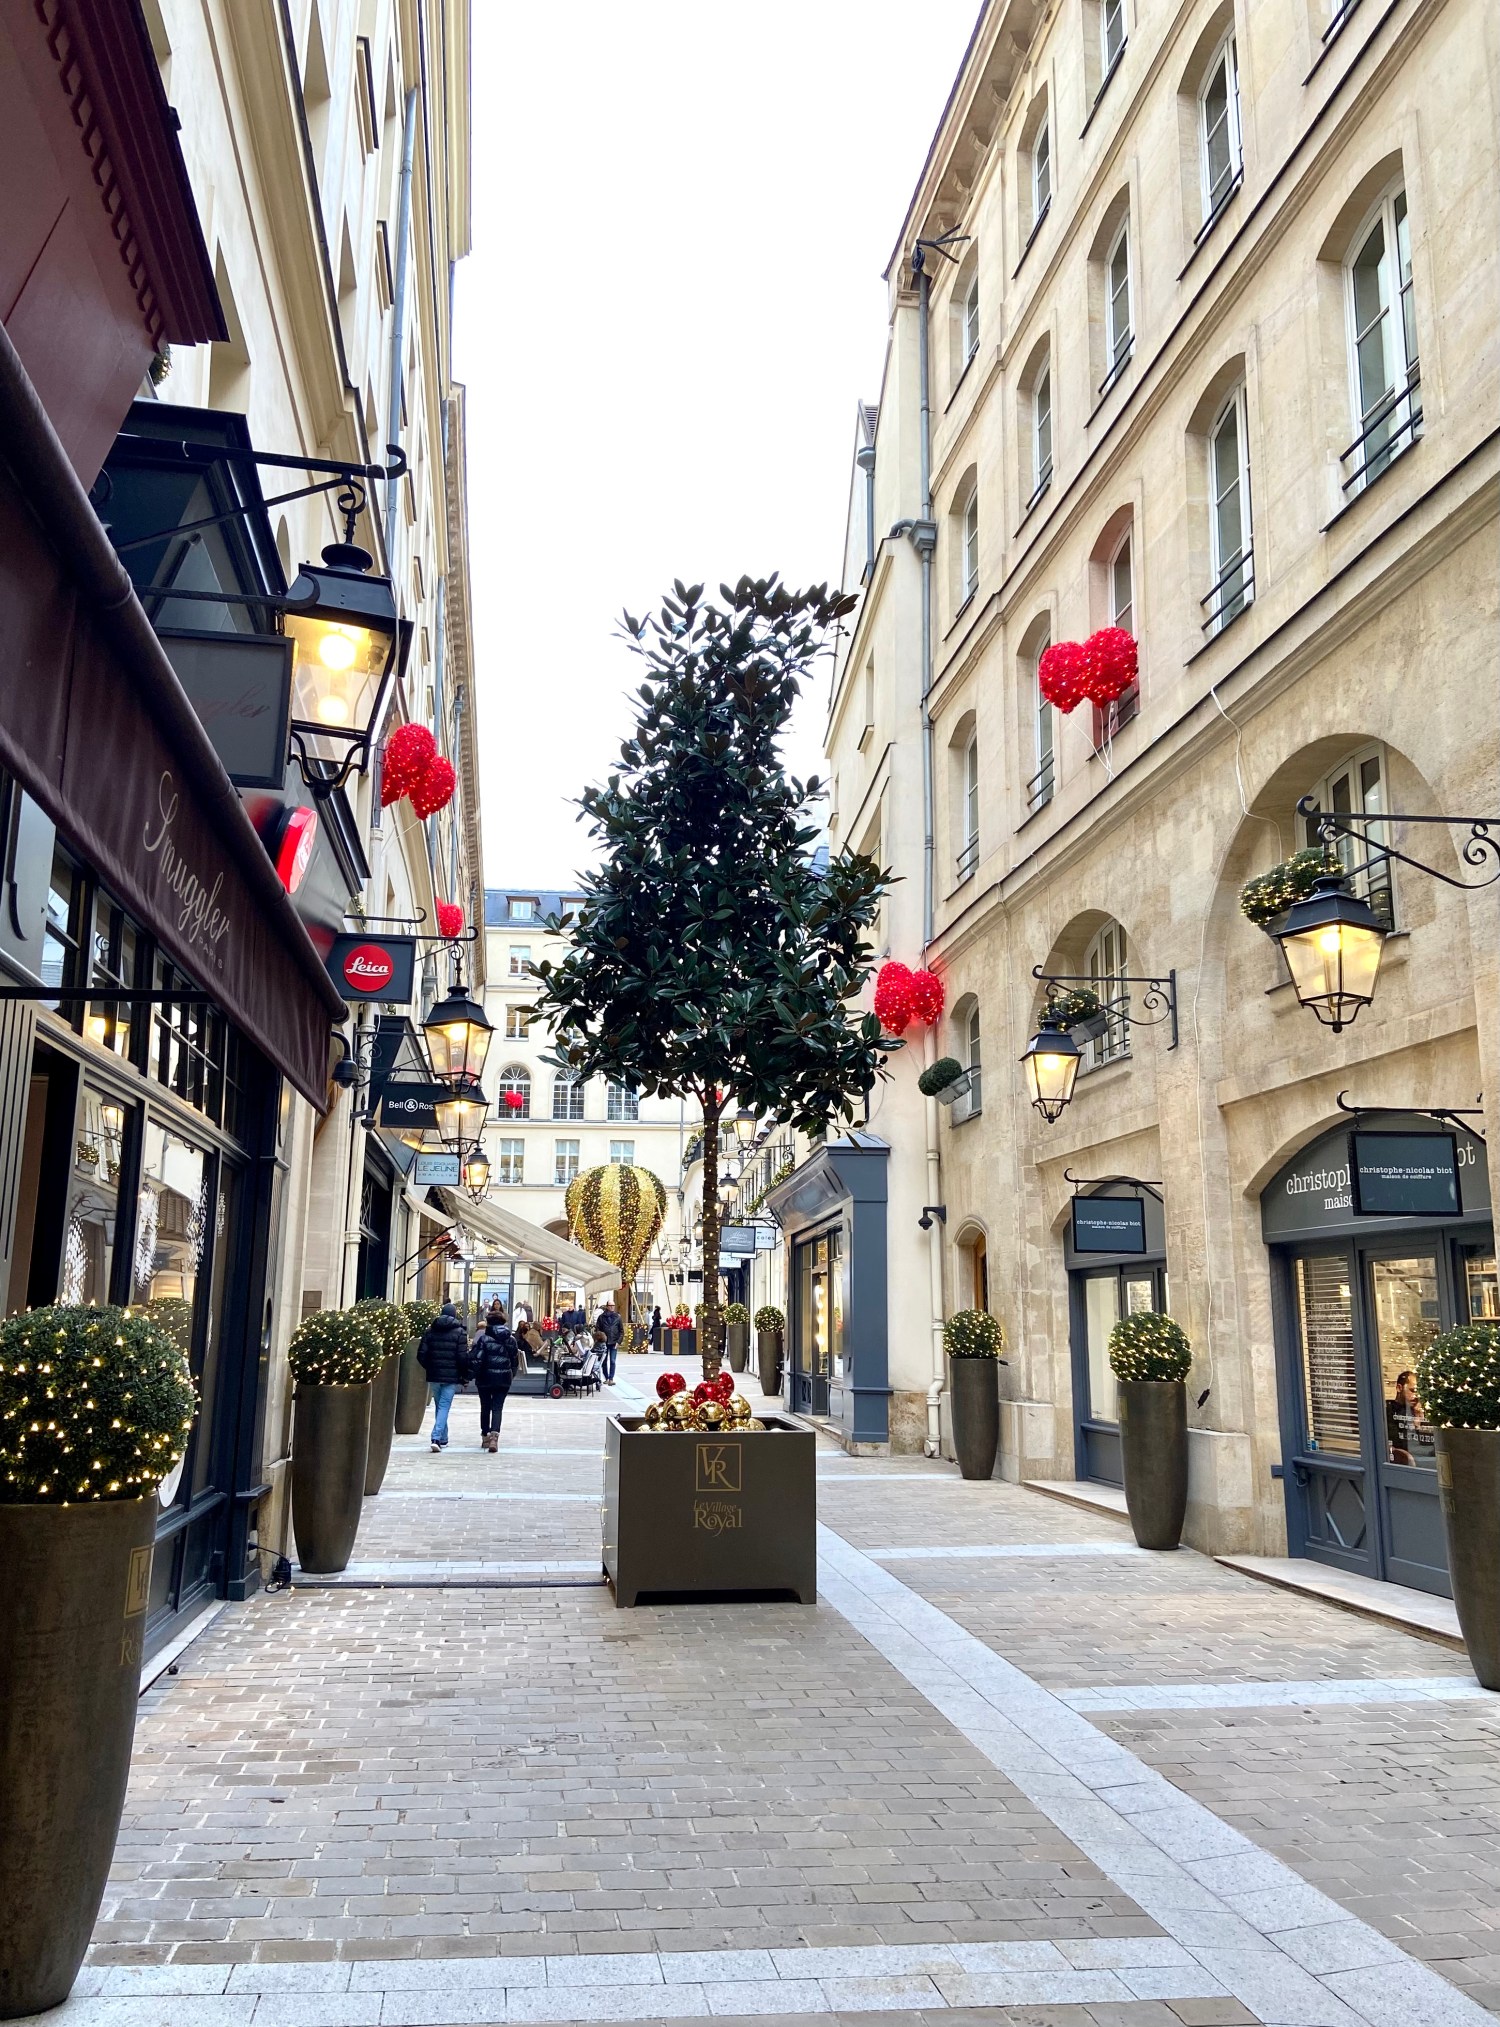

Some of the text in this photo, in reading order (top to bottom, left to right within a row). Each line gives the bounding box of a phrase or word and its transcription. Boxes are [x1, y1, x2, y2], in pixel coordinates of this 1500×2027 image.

[143, 771, 230, 943] Smuggler
[199, 936, 223, 969] PARIS
[346, 957, 390, 977] Leica
[388, 1099, 435, 1111] Bell & Ros
[429, 1165, 458, 1173] JEUNE
[1359, 1166, 1453, 1175] christophe-nicolas biot
[700, 1446, 739, 1490] VR
[694, 1499, 738, 1516] Le Village
[692, 1508, 744, 1538] Royal
